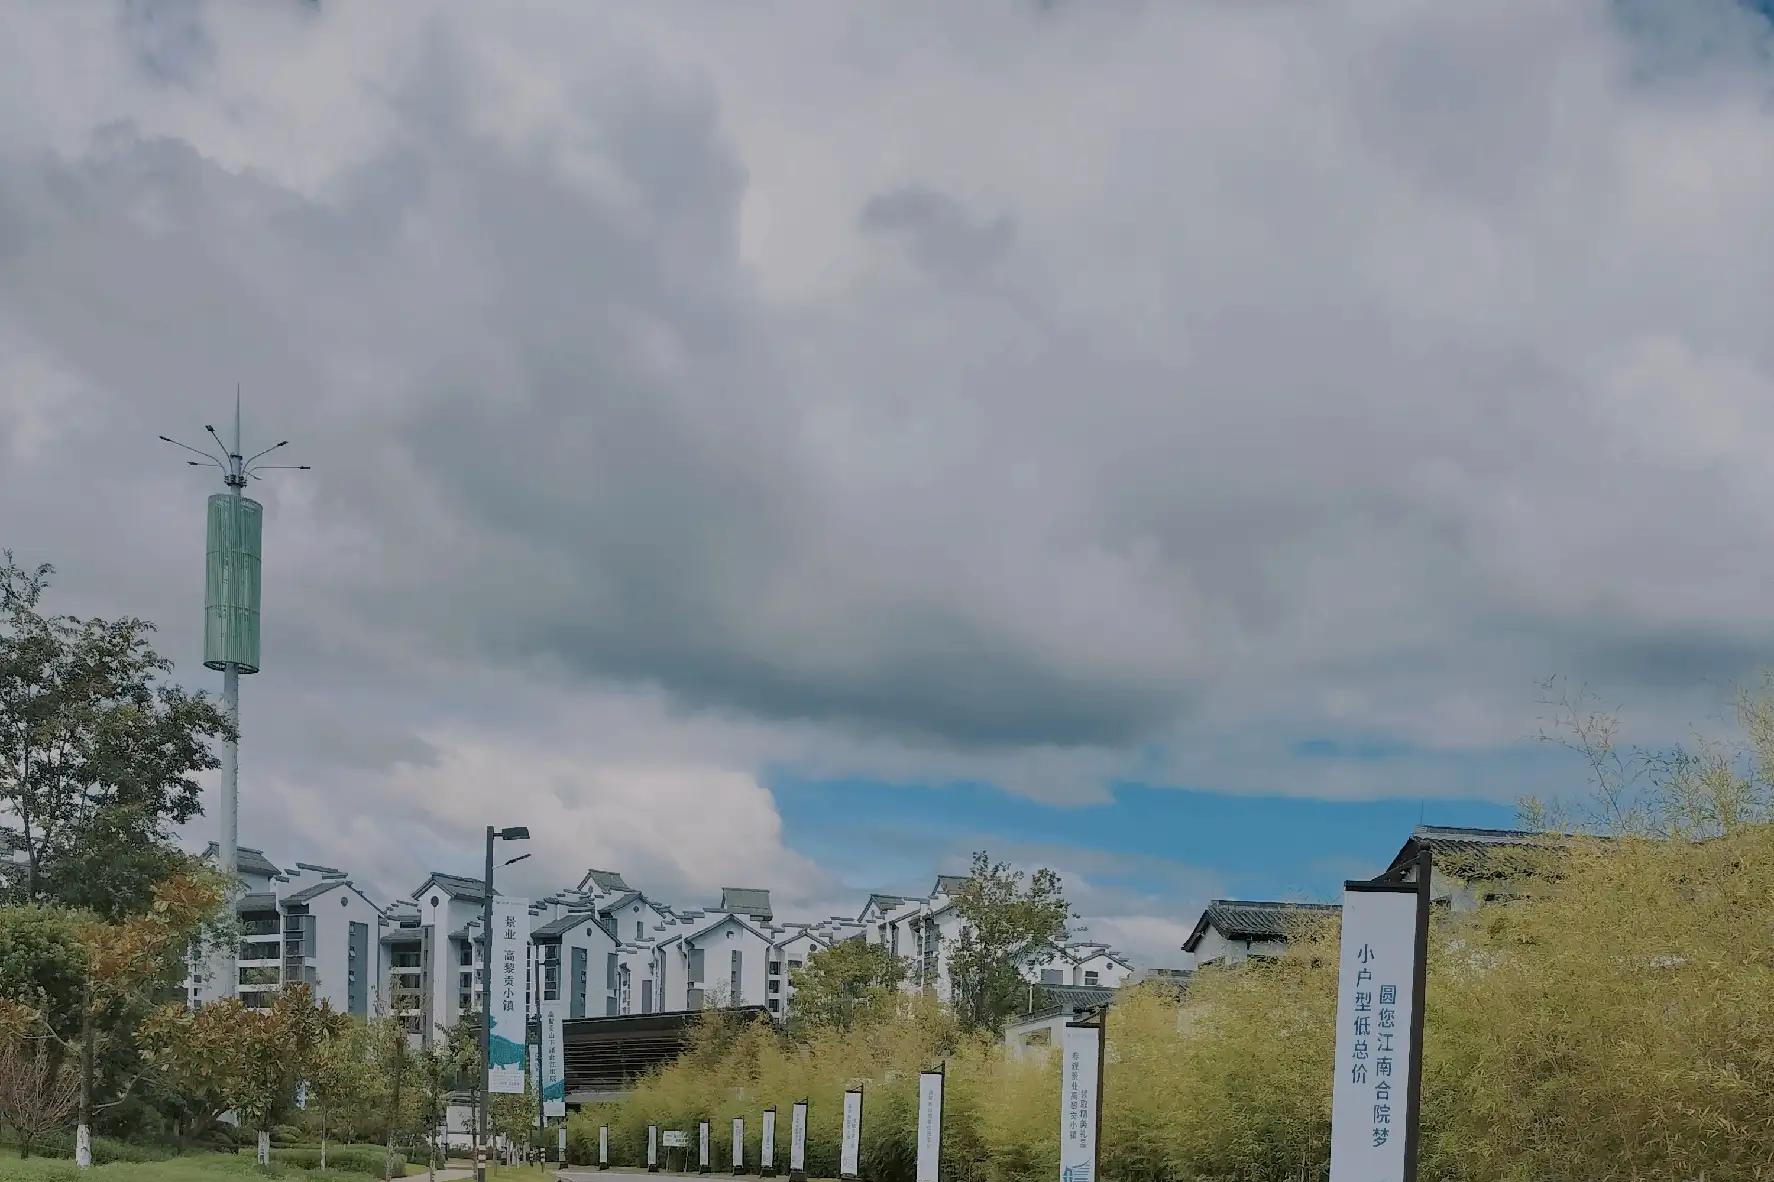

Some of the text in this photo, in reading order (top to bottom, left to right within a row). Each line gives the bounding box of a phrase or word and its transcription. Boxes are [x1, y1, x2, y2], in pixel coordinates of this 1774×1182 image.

[503, 915, 516, 940] 景业
[502, 950, 515, 1011] 高黎贡小镇
[1351, 943, 1375, 1085] 小户型低总价
[1371, 984, 1397, 1148] 圆您江南合院梦
